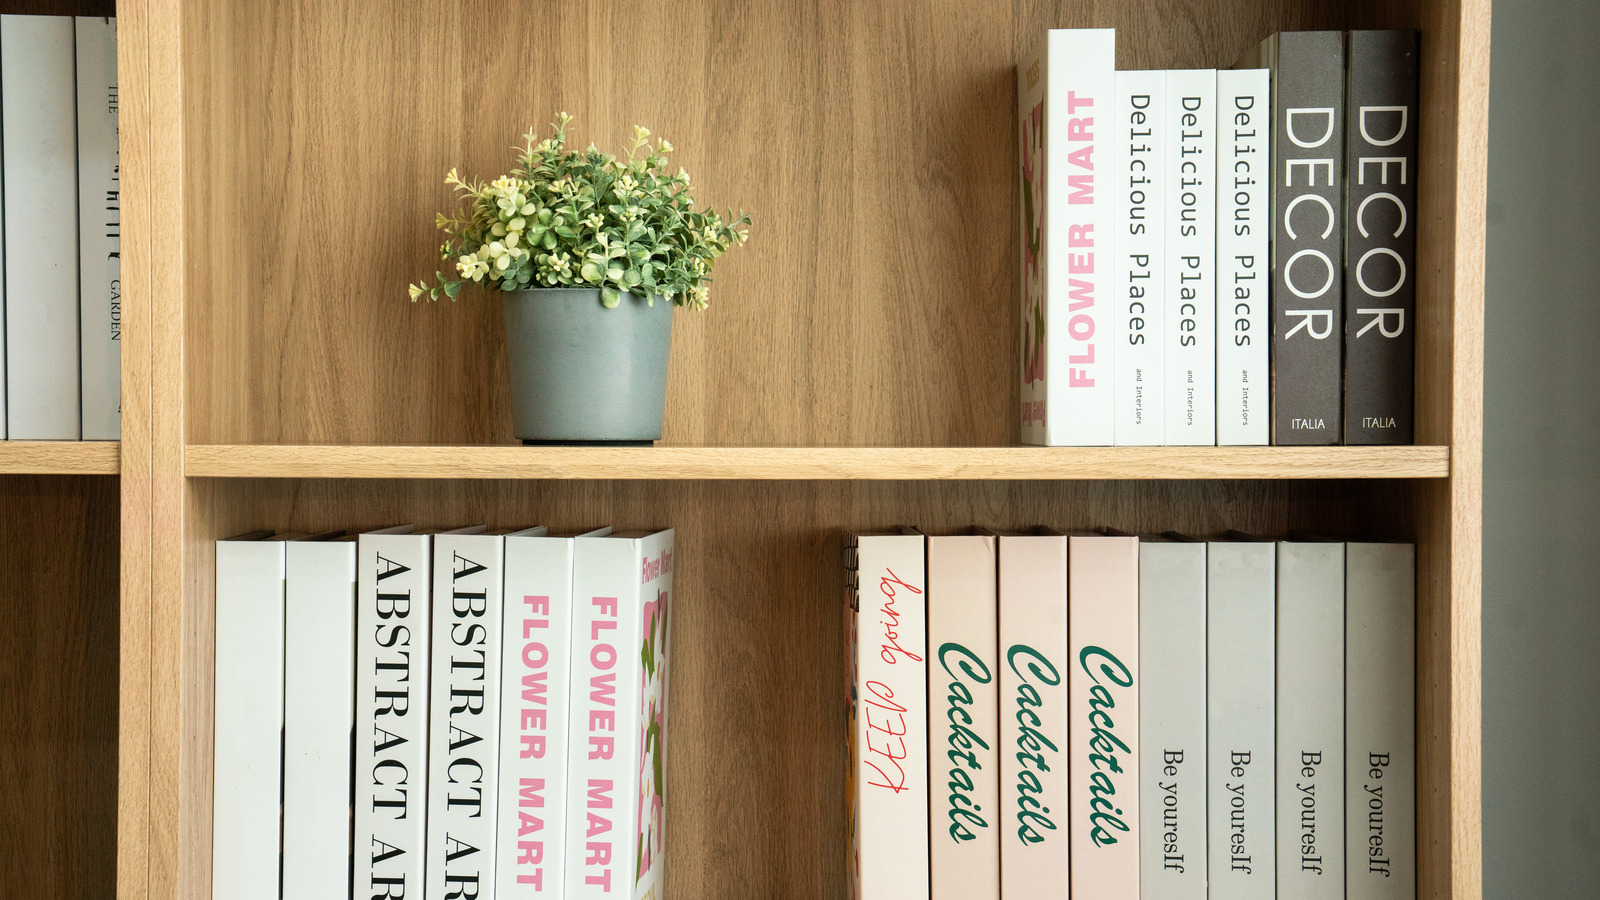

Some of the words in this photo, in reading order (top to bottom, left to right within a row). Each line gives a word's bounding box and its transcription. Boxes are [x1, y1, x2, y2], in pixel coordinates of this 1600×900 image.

[109, 83, 119, 114] THE
[1067, 91, 1095, 205] MART
[1129, 94, 1151, 236] Delicious
[1180, 96, 1202, 237] Delicious
[1234, 95, 1256, 237] Delicious
[1284, 107, 1335, 341] DECOR
[1355, 105, 1408, 339] DECOR
[110, 279, 121, 340] GARDEN
[1068, 222, 1095, 388] FLOWER
[1128, 254, 1151, 346] Places
[1180, 255, 1202, 347] Places
[1234, 255, 1256, 347] Places
[1135, 369, 1143, 382] and
[1135, 386, 1143, 425] Interiors
[1187, 387, 1195, 426] Interiors
[1242, 387, 1250, 426] Interiors
[1291, 418, 1326, 430] ITALIA
[1362, 417, 1397, 429] ITALIA
[642, 556, 660, 585] Flower
[880, 567, 923, 665] going
[372, 551, 412, 820] ABSTRACT
[446, 550, 488, 818] ABSTRACT
[519, 595, 550, 759] FLOWER
[588, 597, 618, 761] FLOWER
[938, 642, 992, 845] Cacktails
[1006, 643, 1061, 847] Cacktails
[1079, 645, 1134, 848] Cacktails
[1163, 748, 1184, 777] Be
[1230, 749, 1252, 778] Be
[1300, 749, 1322, 778] Be
[1368, 751, 1390, 780] Be
[516, 777, 546, 891] MART
[584, 779, 614, 892] MART
